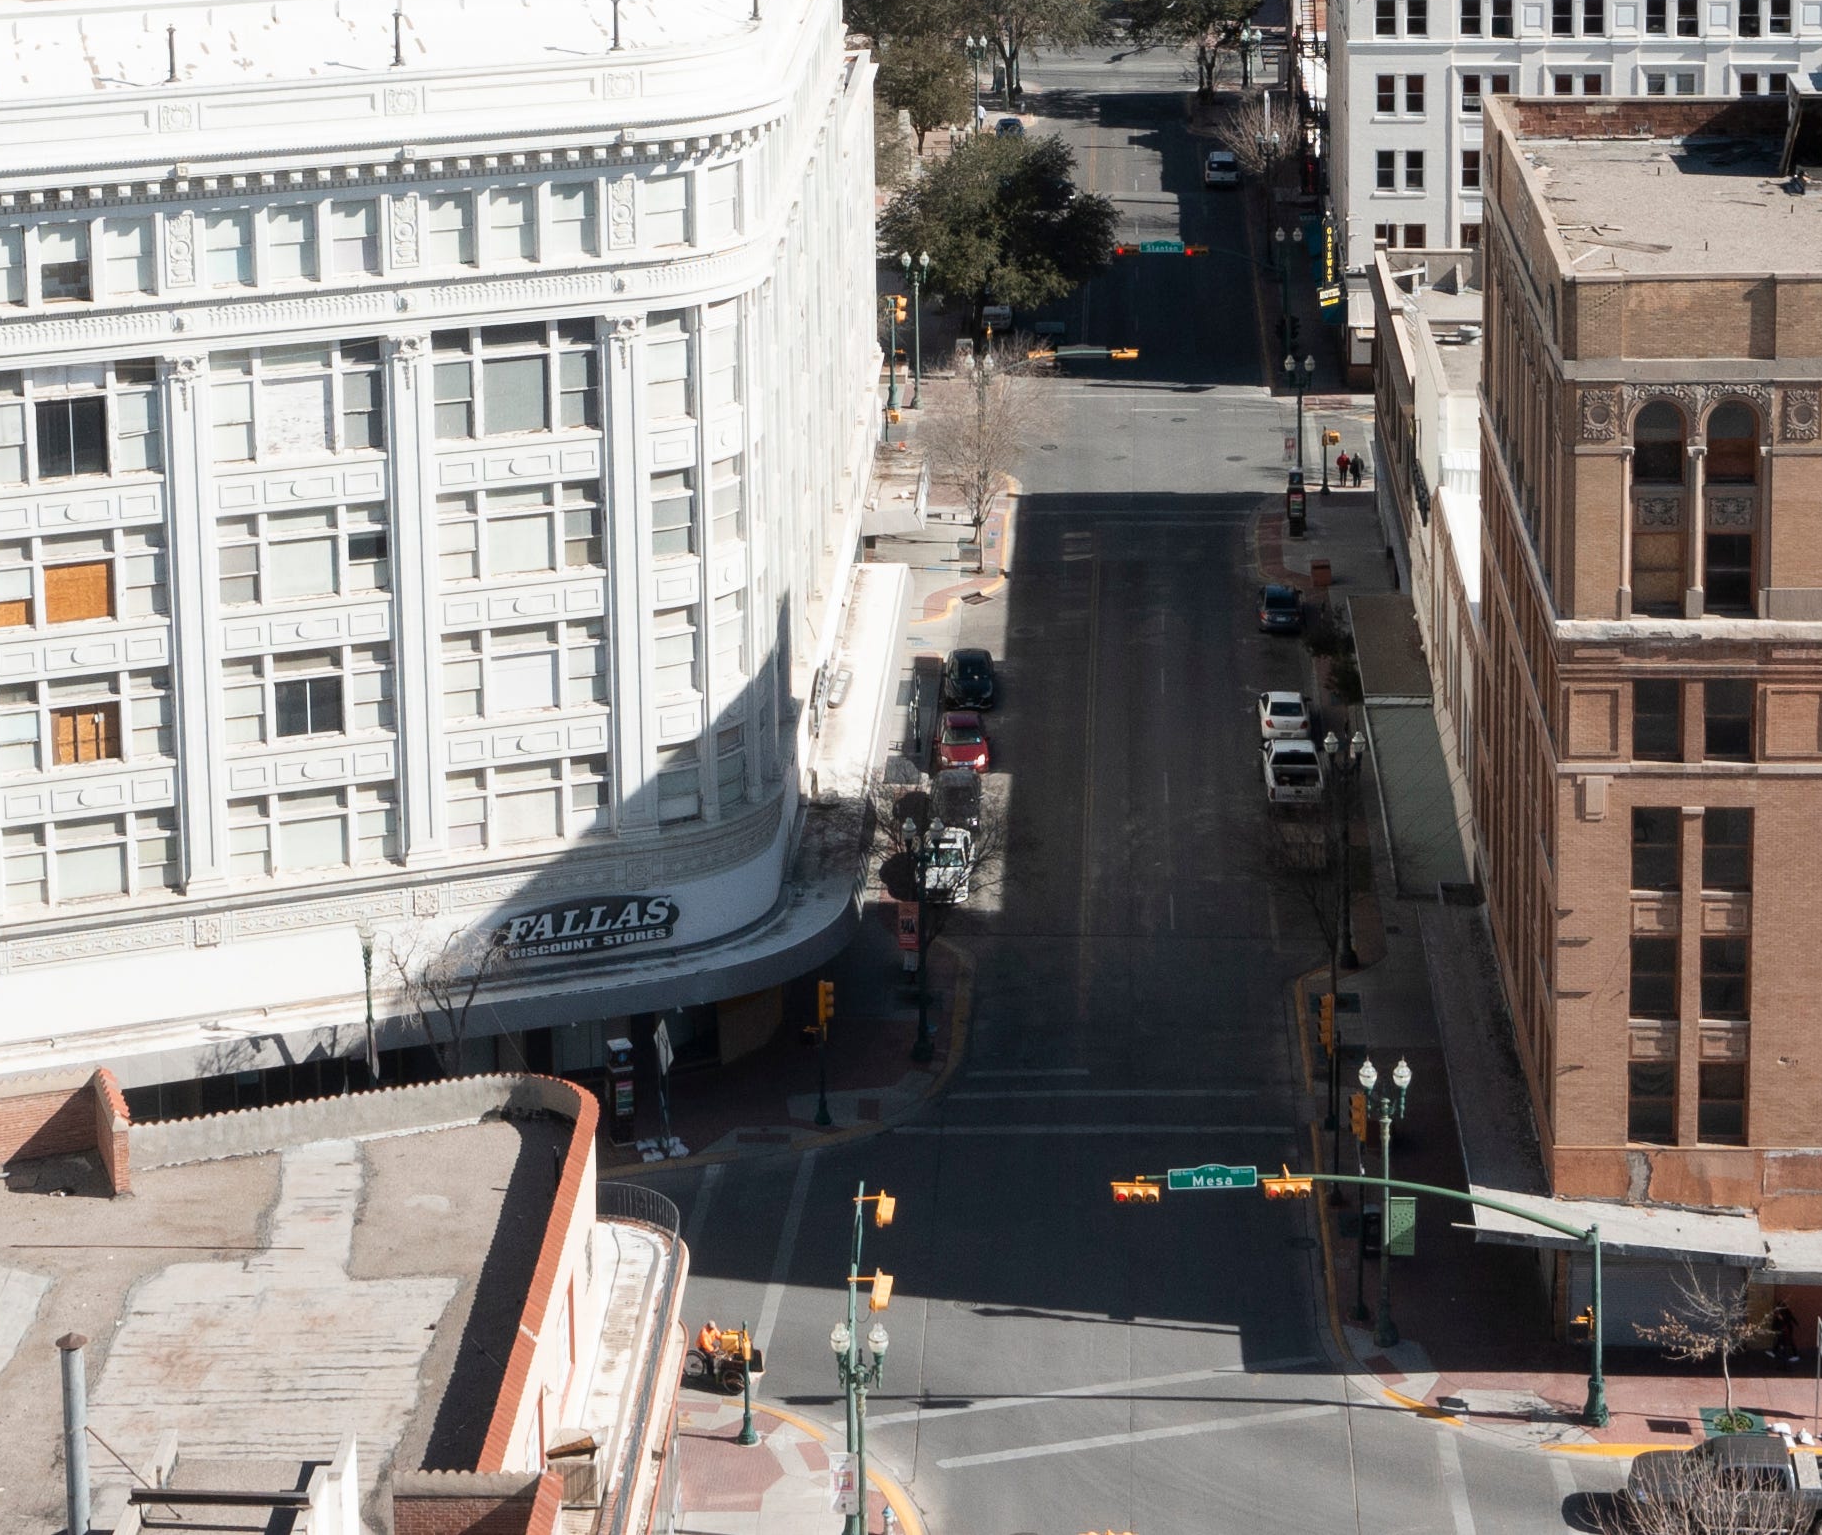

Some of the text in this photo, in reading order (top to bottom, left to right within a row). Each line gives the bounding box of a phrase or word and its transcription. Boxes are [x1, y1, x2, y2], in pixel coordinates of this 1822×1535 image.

[503, 896, 673, 945] FALLAS
[510, 928, 667, 959] DISCOUNT STORES
[1192, 1175, 1233, 1187] Mesa
